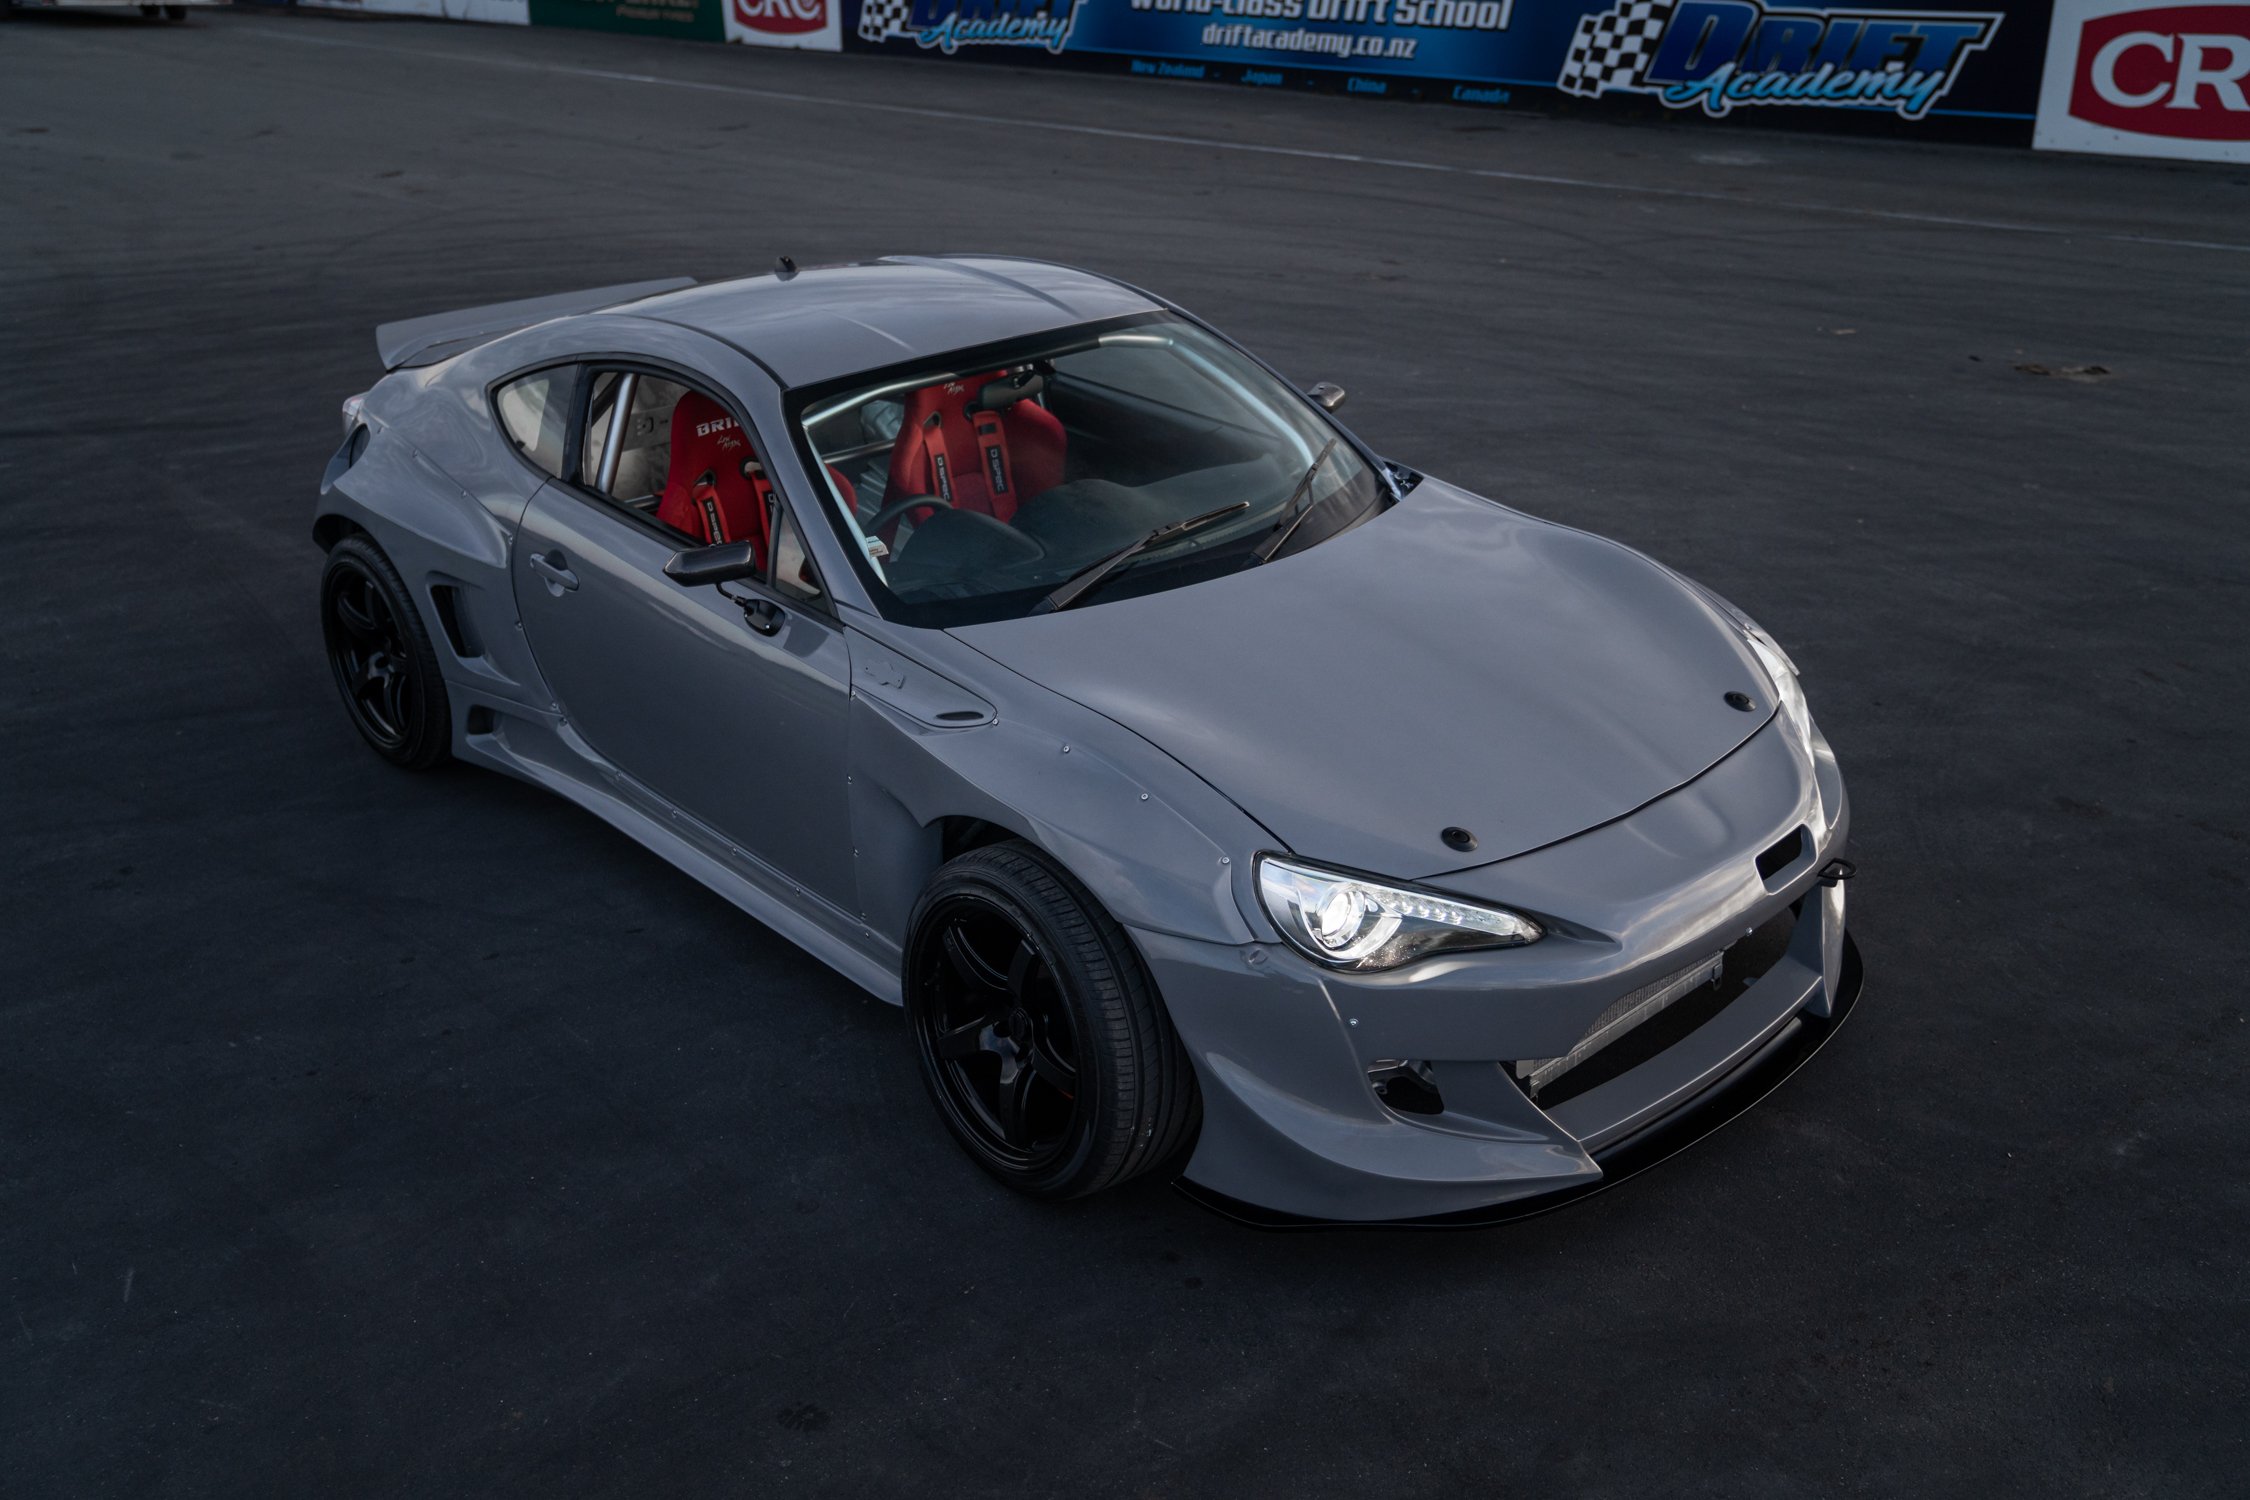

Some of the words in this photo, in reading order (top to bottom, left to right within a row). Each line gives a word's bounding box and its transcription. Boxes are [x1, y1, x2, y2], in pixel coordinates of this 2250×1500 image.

[918, 11, 1068, 49] Academy
[1394, 0, 1514, 31] School
[1201, 22, 1419, 60] driftacademy.co.nz
[1240, 67, 1283, 87] Japan
[1346, 75, 1389, 95] China
[1452, 82, 1512, 105] Canada
[1663, 61, 1946, 113] Academy
[992, 459, 1005, 493] SPEC
